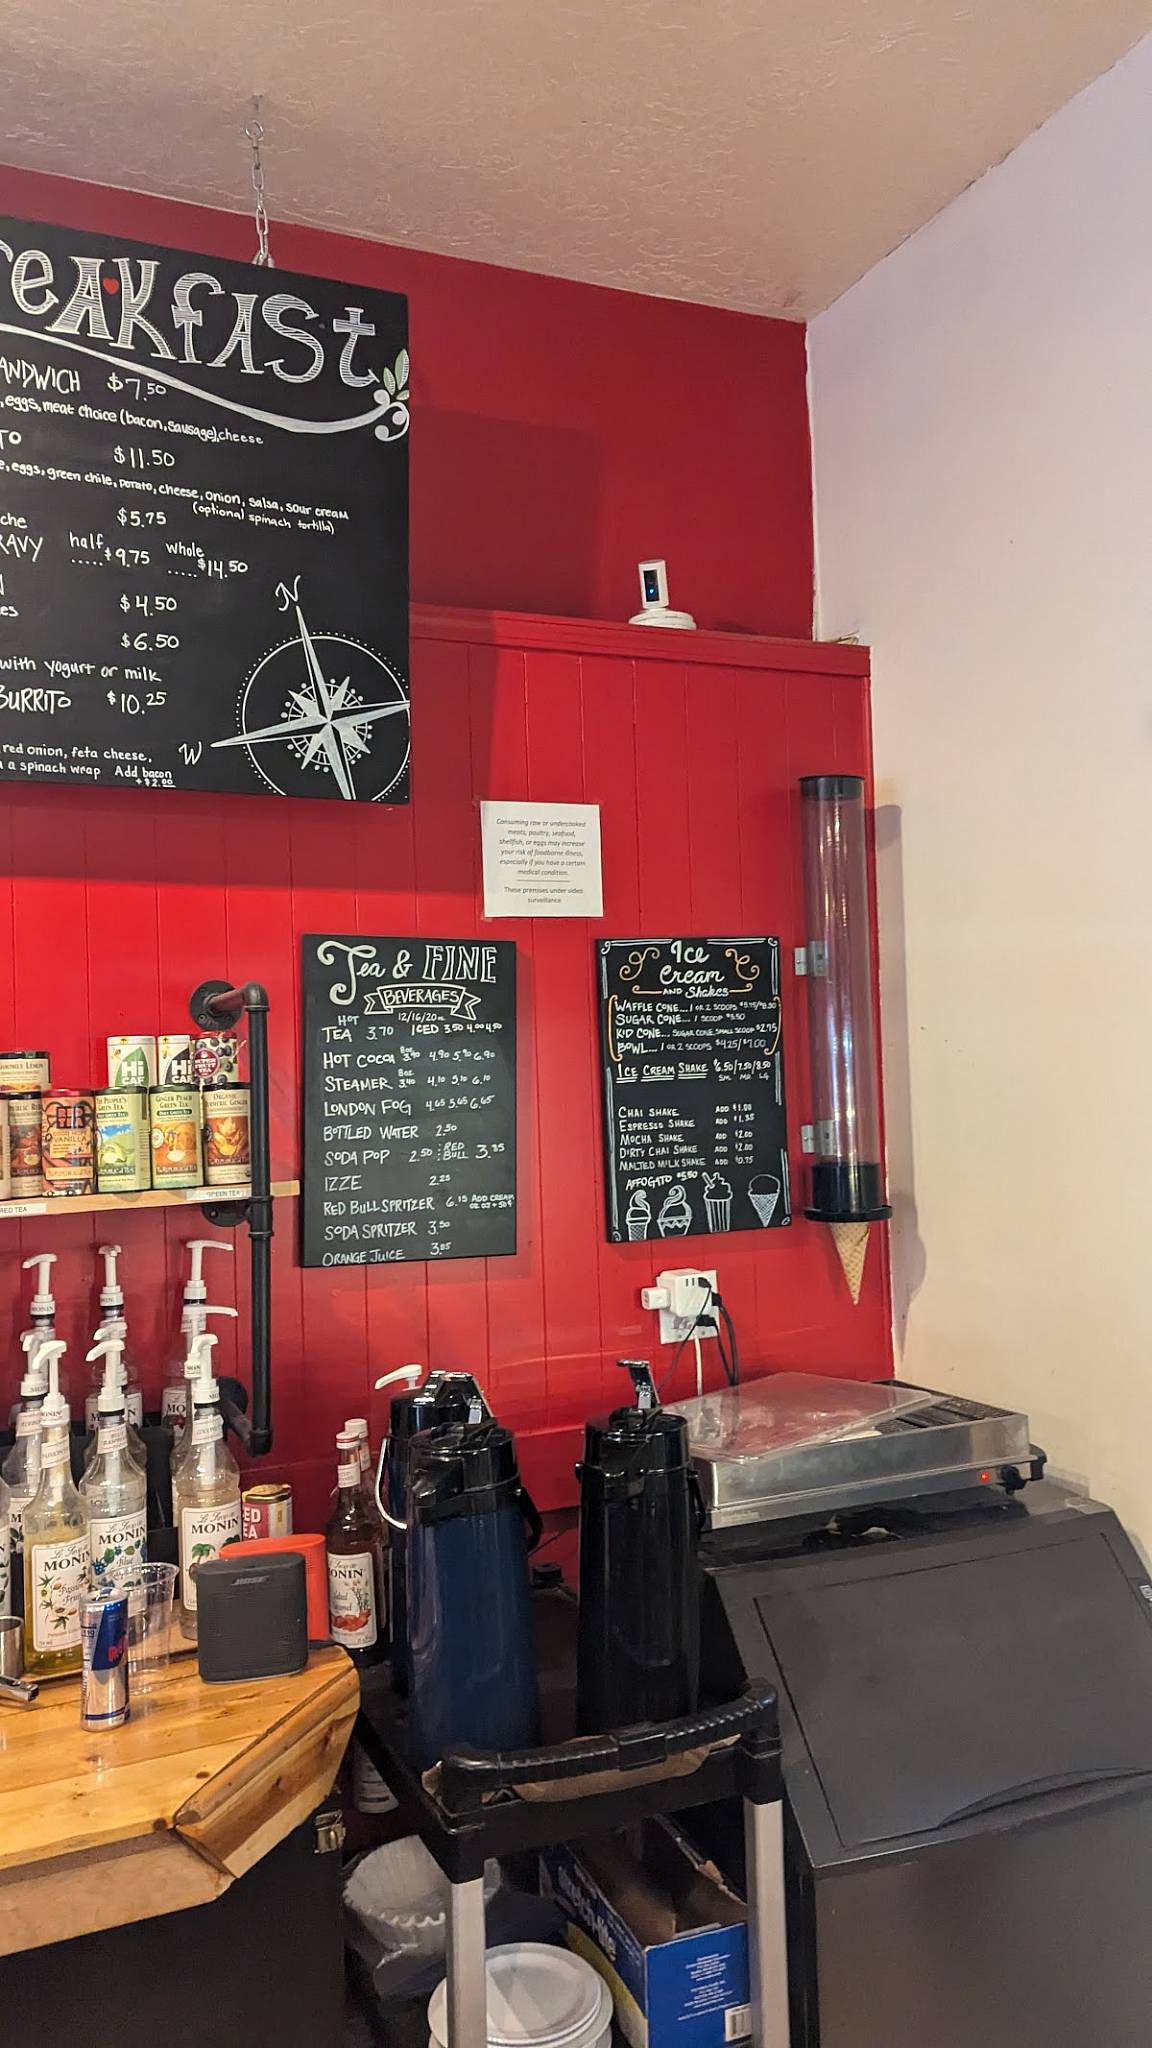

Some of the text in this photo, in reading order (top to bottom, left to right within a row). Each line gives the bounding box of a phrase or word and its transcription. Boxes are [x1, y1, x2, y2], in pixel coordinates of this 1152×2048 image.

[107, 372, 168, 402] $7.50
[5, 395, 42, 412] eggs,
[42, 400, 75, 416] meat
[78, 404, 117, 423] choice
[218, 427, 264, 444] cheese
[113, 445, 175, 469] $11.50
[11, 461, 46, 476] eggs,
[46, 467, 81, 481] green
[84, 472, 118, 488] chile,
[160, 484, 204, 501] cheese,
[205, 491, 245, 507] onion,
[248, 498, 284, 512] salsa,
[285, 502, 312, 516] sour
[314, 507, 350, 521] cream
[118, 507, 166, 528] $5.75
[192, 502, 334, 535] (optional spinach tortilla)
[70, 532, 205, 558] half whole
[105, 549, 151, 570] $9.75
[197, 558, 249, 579] $14.50
[275, 575, 302, 613] N
[119, 595, 177, 617] $4.50
[120, 633, 180, 653] $6.50
[0, 657, 163, 682] with yogurt or milk
[106, 690, 167, 715] $10.25
[2, 742, 152, 764] red onion, feta cheese,
[178, 741, 203, 766] W
[8, 761, 173, 780] a spinach wrap Add bacon
[670, 940, 710, 964] Ice
[317, 940, 498, 1006] Tea & FINE
[659, 965, 726, 985] Cream
[383, 988, 460, 1005] BEVERAGES
[662, 985, 730, 999] AND Shakes
[615, 1000, 653, 1012] WAFFLE
[338, 1015, 360, 1026] HOT
[615, 1013, 655, 1026] SUGAR
[321, 1026, 353, 1043] TEA
[366, 1026, 394, 1041] 3.70
[411, 1024, 440, 1036] ICED
[616, 1028, 634, 1039] KID
[122, 1060, 144, 1077] Hi
[323, 1052, 352, 1070] HOT
[357, 1053, 396, 1069] COCOA
[429, 1049, 450, 1061] 4.90
[473, 1049, 496, 1061] 6.90
[617, 1062, 709, 1078] ICE CREAM SHAKE
[324, 1076, 393, 1093] STEAMER
[324, 1101, 376, 1117] LONDON
[382, 1099, 412, 1116] FOG
[618, 1106, 681, 1120] CHAI SHAKE
[323, 1124, 458, 1142] BOTTLED WATER 2.50
[618, 1119, 696, 1132] ESPRESSO SHAKE
[443, 1142, 465, 1151] RED
[620, 1133, 685, 1146] MOCHA SHAKE
[325, 1149, 469, 1167] SODA POP 2.50 BULL
[619, 1144, 698, 1159] DIRTY CHAI SHAKE
[619, 1158, 707, 1172] MALTED MILK SHAKE
[325, 1174, 363, 1192] IZZE
[626, 1174, 673, 1191] AFFOGATO
[323, 1202, 346, 1217] RED
[350, 1200, 381, 1215] BULL
[382, 1197, 436, 1213] SPRITZER
[324, 1226, 359, 1241] SODA
[362, 1221, 419, 1239] SPRITZER
[321, 1252, 367, 1268] ORANGE
[369, 1249, 407, 1262] JUICE
